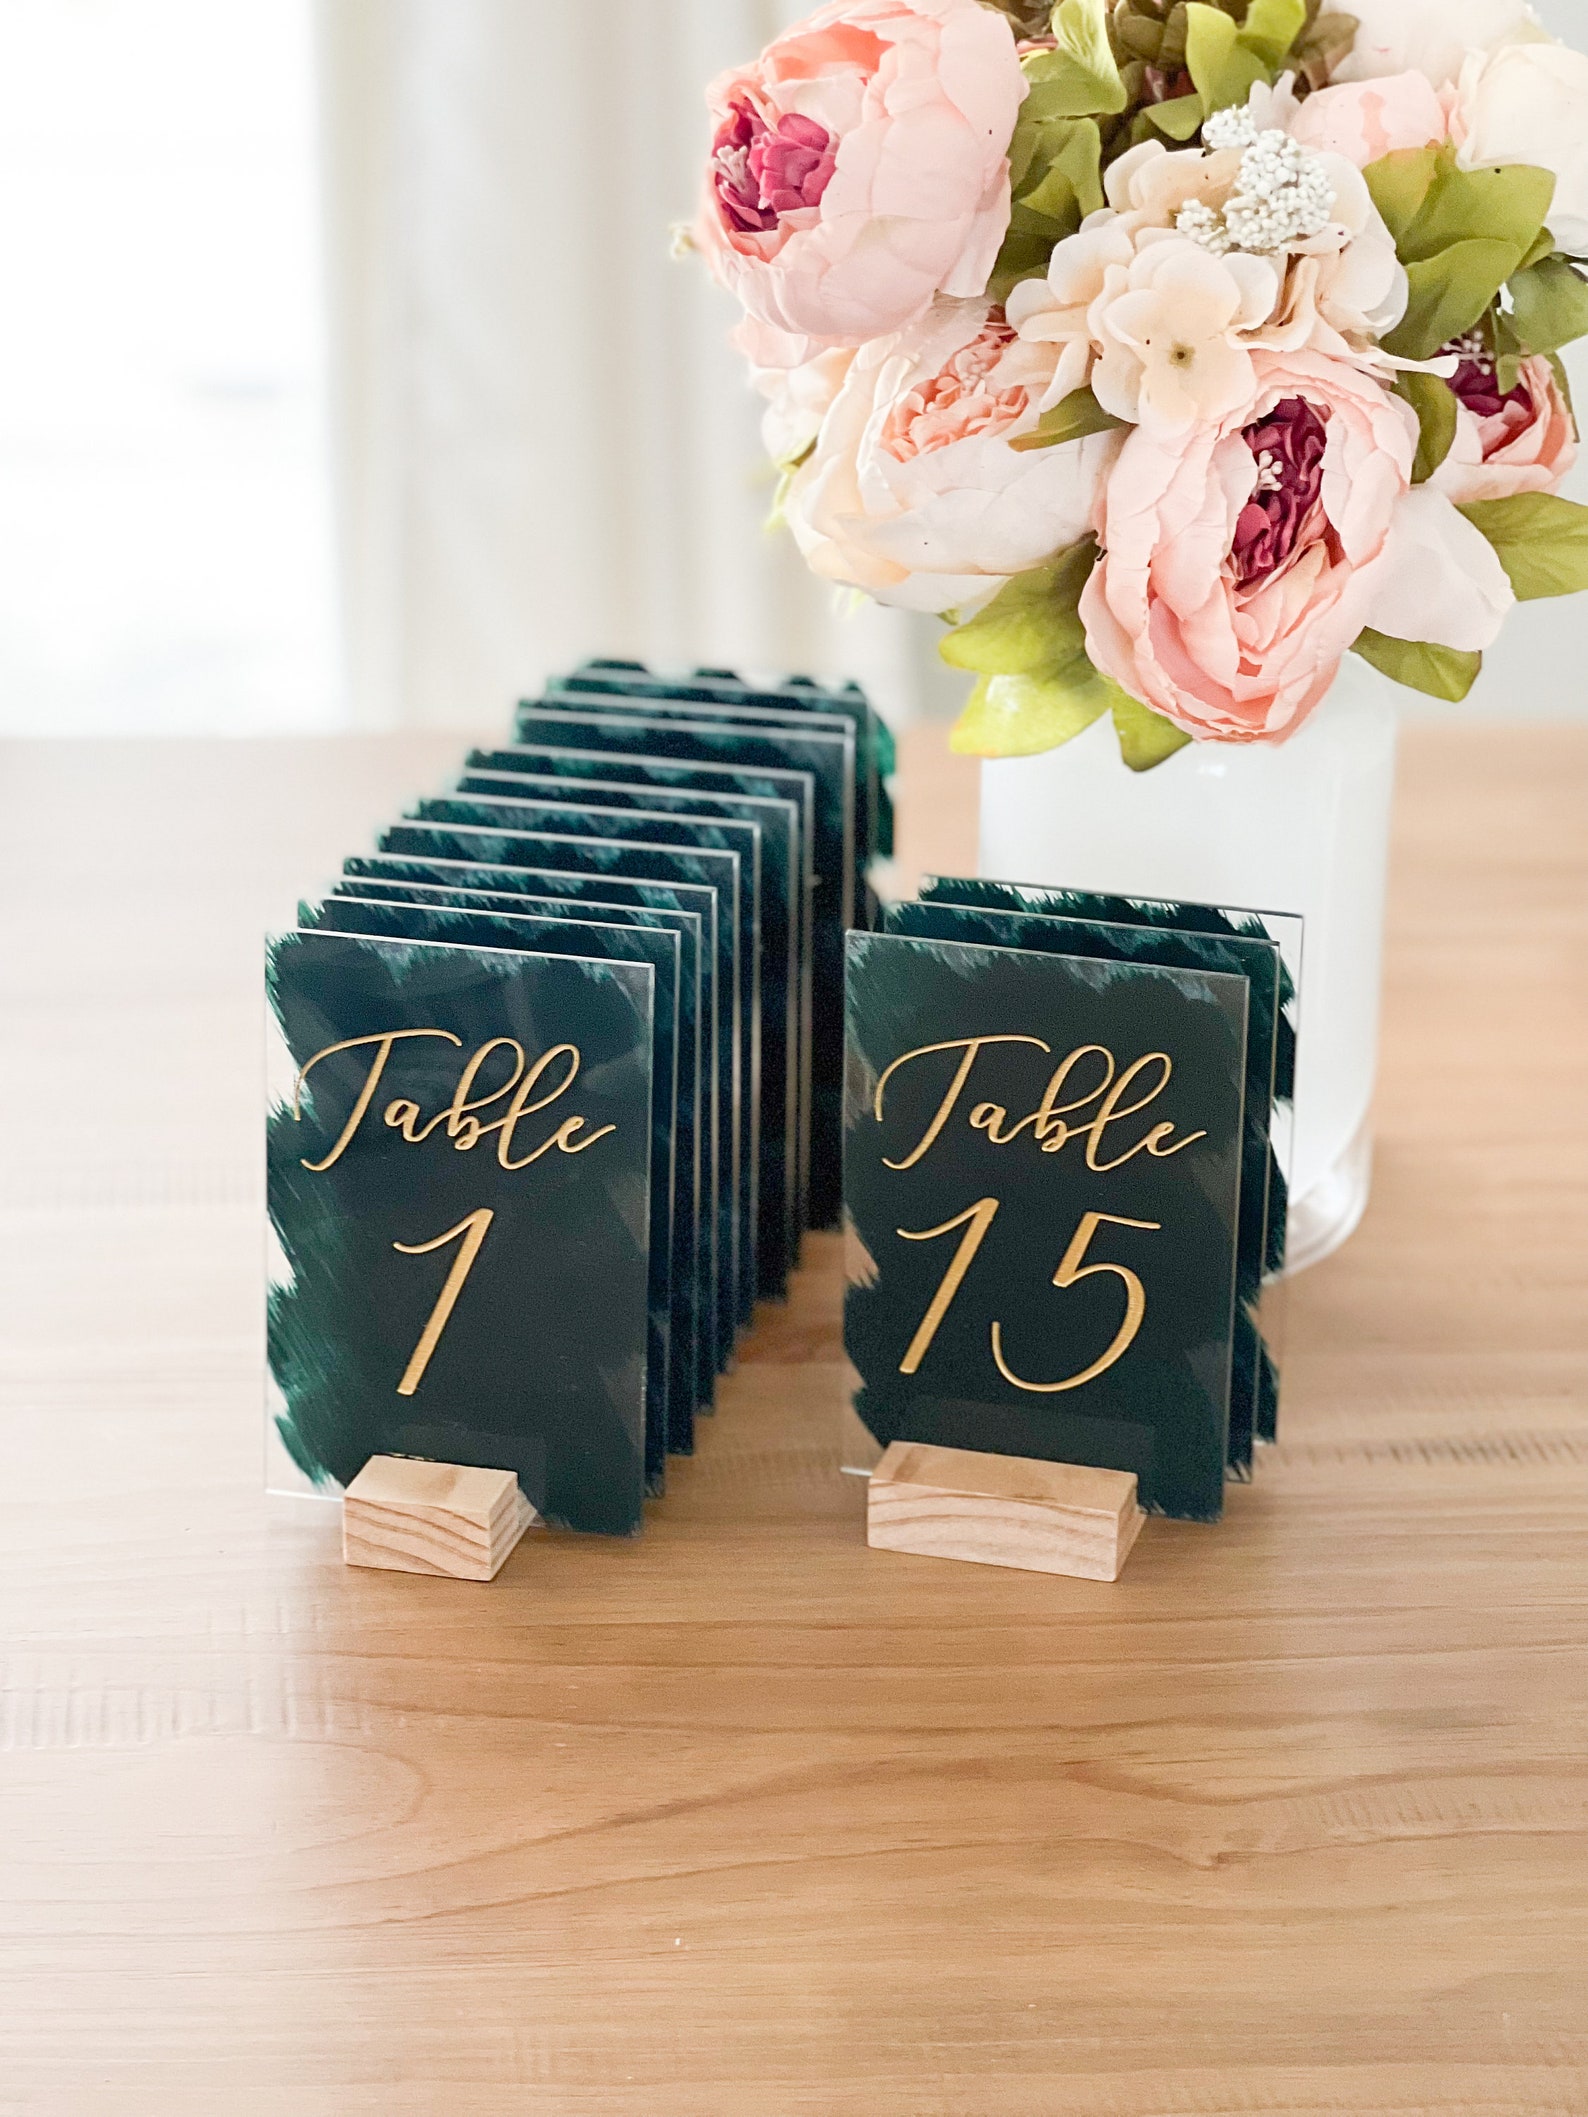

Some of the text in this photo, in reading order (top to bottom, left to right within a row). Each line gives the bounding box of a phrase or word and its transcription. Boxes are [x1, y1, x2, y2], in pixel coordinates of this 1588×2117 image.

[293, 1028, 616, 1172] Table
[874, 1034, 1207, 1172] Table
[393, 1208, 494, 1396] 1
[896, 1197, 1161, 1393] 15
